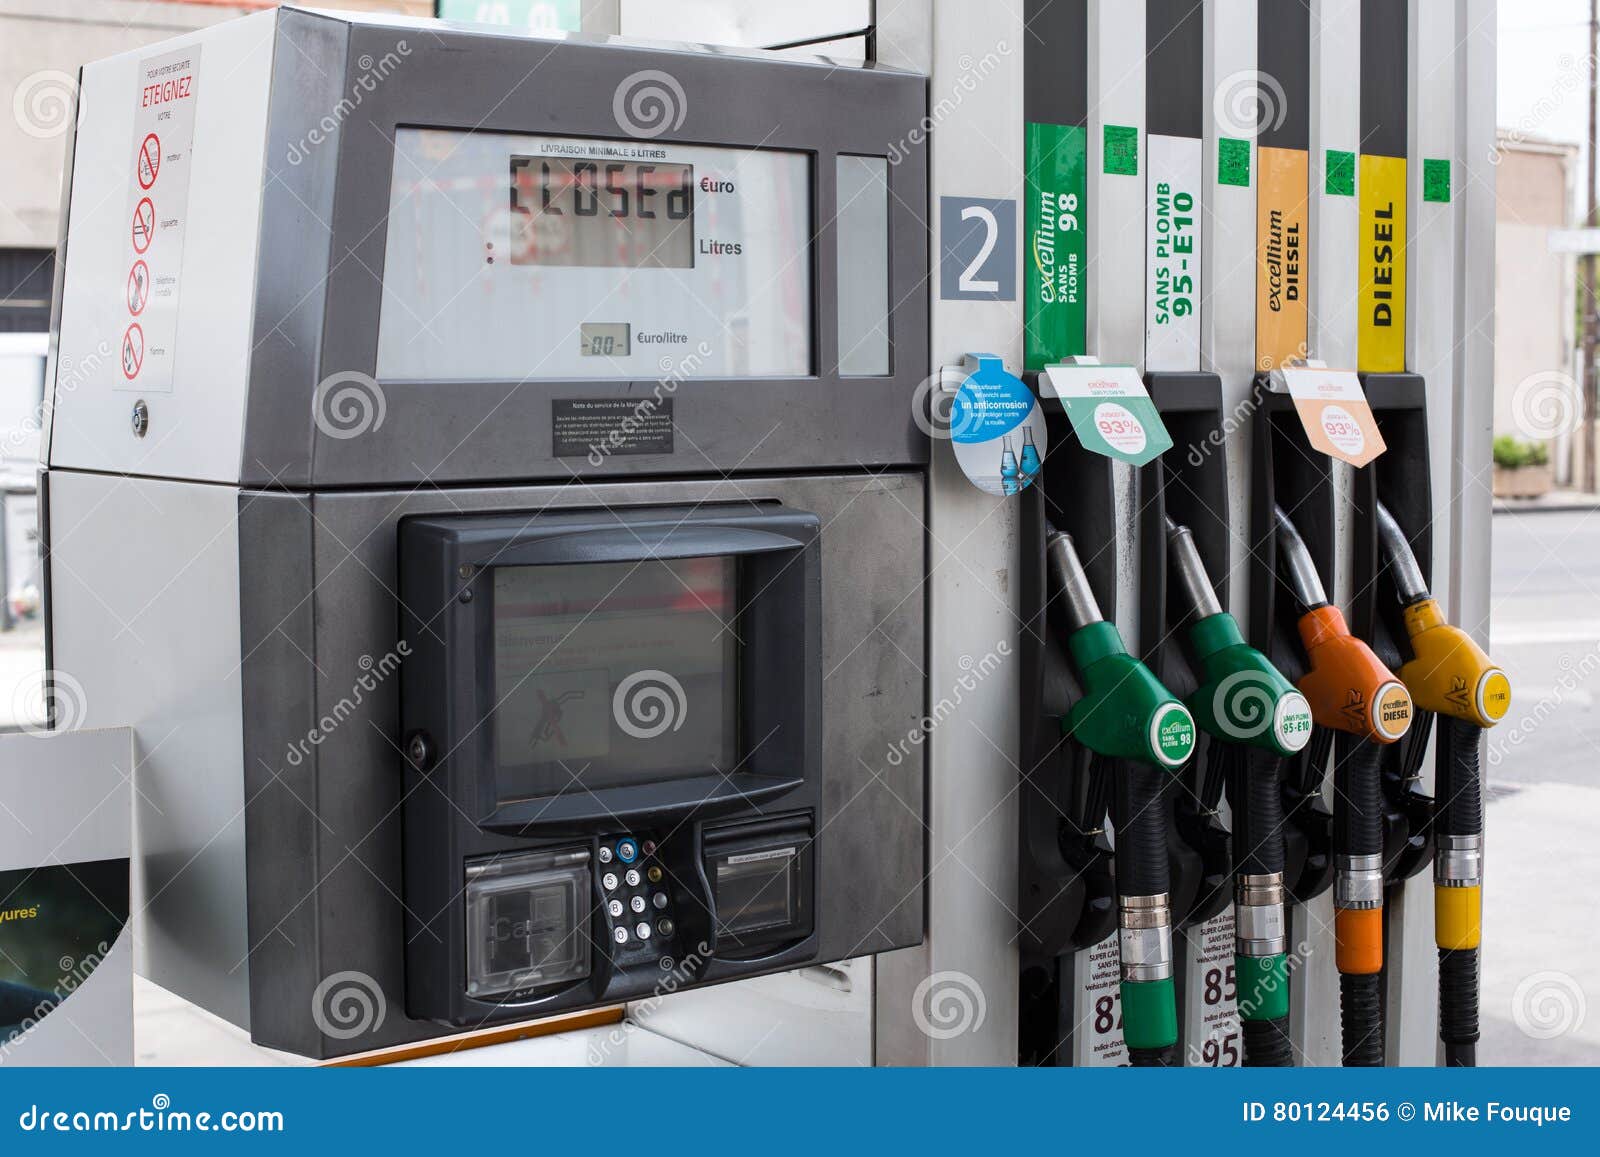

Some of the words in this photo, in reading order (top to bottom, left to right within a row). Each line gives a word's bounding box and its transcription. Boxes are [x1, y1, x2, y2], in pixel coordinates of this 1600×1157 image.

[142, 76, 192, 108] ETEIGNEZ
[541, 143, 587, 155] LIVRAISON
[588, 146, 629, 157] MINIMALE
[630, 148, 636, 157] 5
[637, 149, 667, 159] LITRES
[700, 177, 735, 193] €uro
[1058, 192, 1078, 231] 98
[1156, 182, 1170, 258] PLOMB
[700, 239, 742, 255] Litres
[958, 205, 999, 292] 2
[1034, 191, 1057, 303] excellium
[1173, 192, 1193, 317] 95-E10
[1266, 210, 1282, 312] excellium
[1287, 222, 1299, 301] DIESEL
[1068, 253, 1077, 303] PLOMB
[1374, 202, 1393, 326] DIESEL
[1058, 264, 1067, 303] SANS
[1156, 267, 1170, 325] SANS
[637, 332, 688, 345] €uro/litre
[974, 400, 1028, 409] anticorrosion
[1099, 420, 1141, 434] 93%
[1324, 422, 1361, 436] 93%
[1283, 721, 1310, 734] 95-E10
[1383, 710, 1409, 722] DIESEL
[1180, 733, 1191, 745] 98
[1089, 952, 1106, 962] SUPER
[1098, 960, 1112, 969] SANS
[1204, 964, 1237, 1006] 85
[1202, 1033, 1239, 1067] 95
